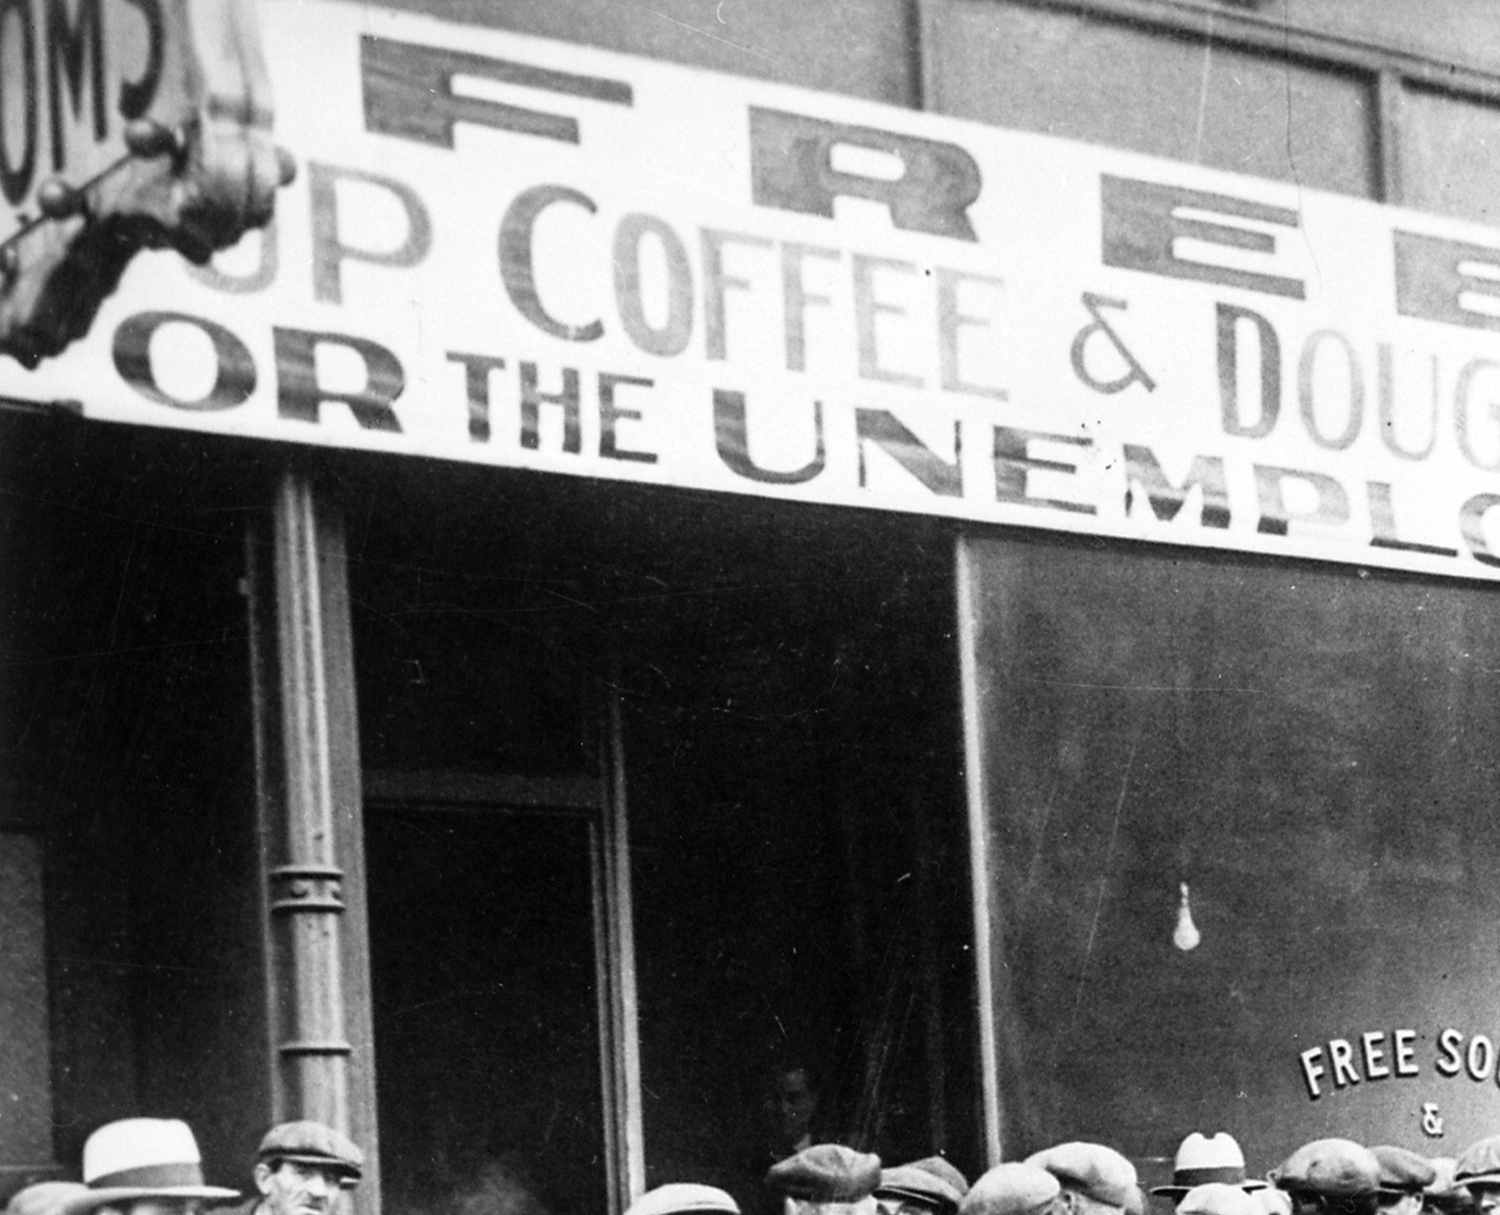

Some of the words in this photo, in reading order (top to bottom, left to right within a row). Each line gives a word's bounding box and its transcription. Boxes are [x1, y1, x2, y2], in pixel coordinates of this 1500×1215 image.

[498, 183, 1010, 402] COFFEE
[1070, 291, 1157, 395] &
[112, 310, 406, 434] OR
[445, 351, 659, 464] THE
[1300, 1028, 1420, 1099] FREE
[1420, 1102, 1445, 1136] &
